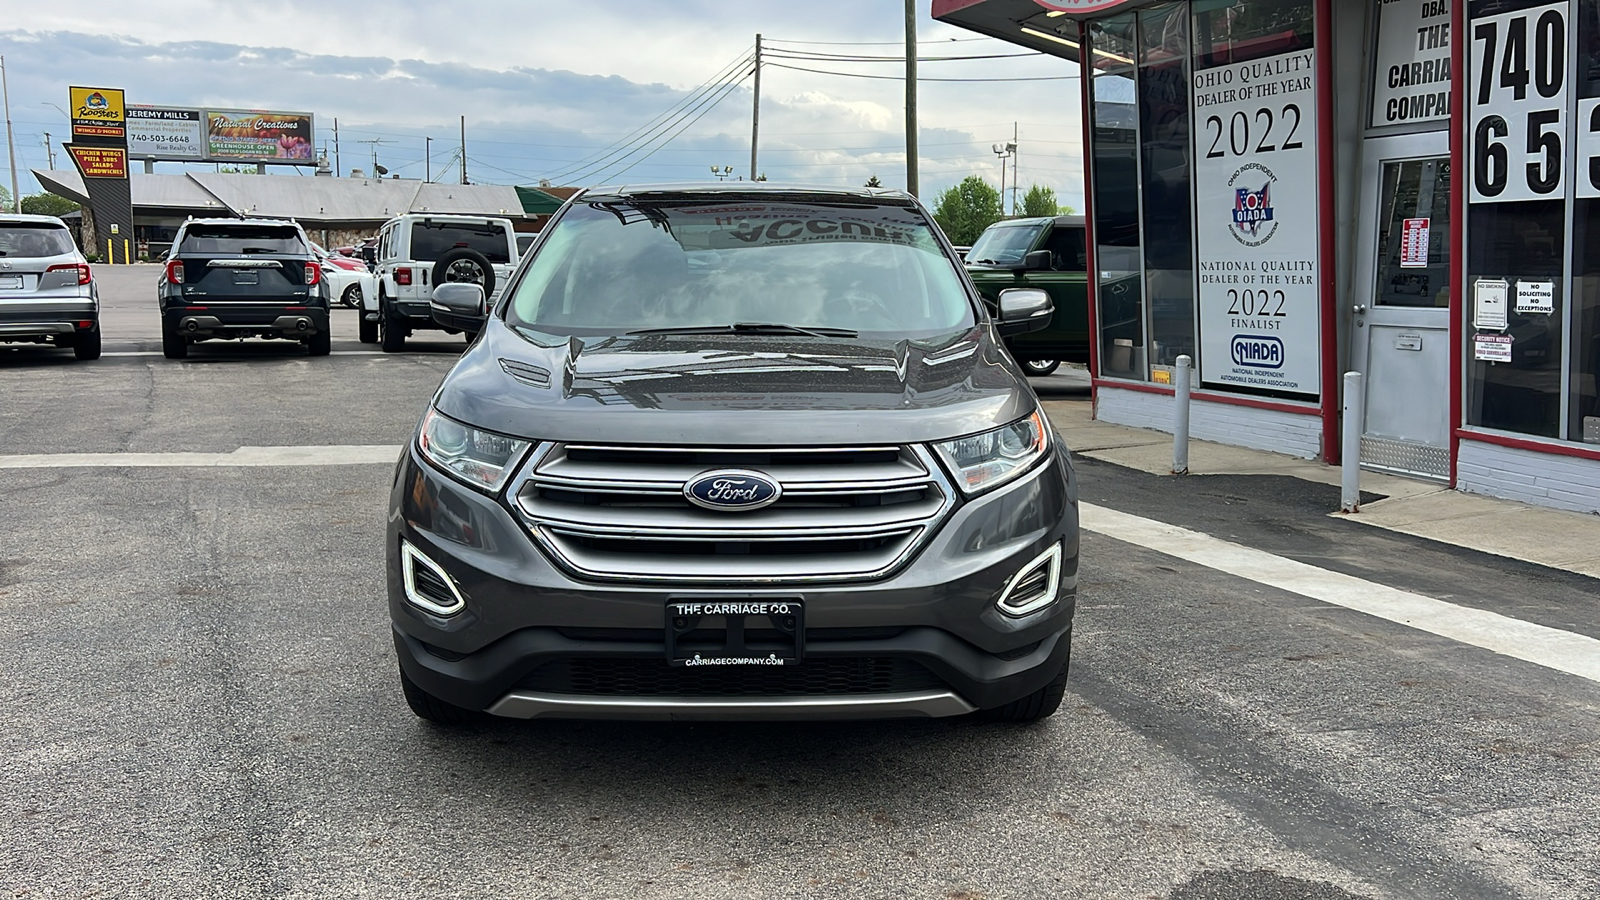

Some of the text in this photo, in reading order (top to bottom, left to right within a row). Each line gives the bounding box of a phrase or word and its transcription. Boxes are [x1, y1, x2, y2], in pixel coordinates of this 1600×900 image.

[1422, 0, 1448, 19] DBA.
[1418, 22, 1450, 51] THE
[1474, 9, 1565, 106] 740
[1194, 54, 1313, 89] OHIO QUALITY
[1197, 90, 1236, 108] DEALER
[1238, 86, 1253, 100] OF
[1255, 82, 1278, 98] THE
[1280, 76, 1312, 94] YEAR
[76, 106, 120, 118] Roosters
[128, 110, 162, 118] JEREMY
[212, 118, 298, 130] Natural Creations
[1206, 104, 1302, 158] 2022
[130, 134, 190, 143] 740-503-6648
[1228, 162, 1278, 187] OHIO INDEPENDENT
[1237, 208, 1267, 222] OIADA
[1200, 261, 1314, 273] NATIONAL QUALITY
[1202, 275, 1313, 285] DEALER OF THE YEAR
[1226, 288, 1287, 317] 2022
[1231, 319, 1281, 330] FINALIST
[1235, 342, 1279, 361] NIADA
[708, 478, 759, 500] Ford
[676, 604, 791, 615] THE CARRIAGE CO.
[685, 658, 784, 666] CARRIAGECOMPANY.COM
